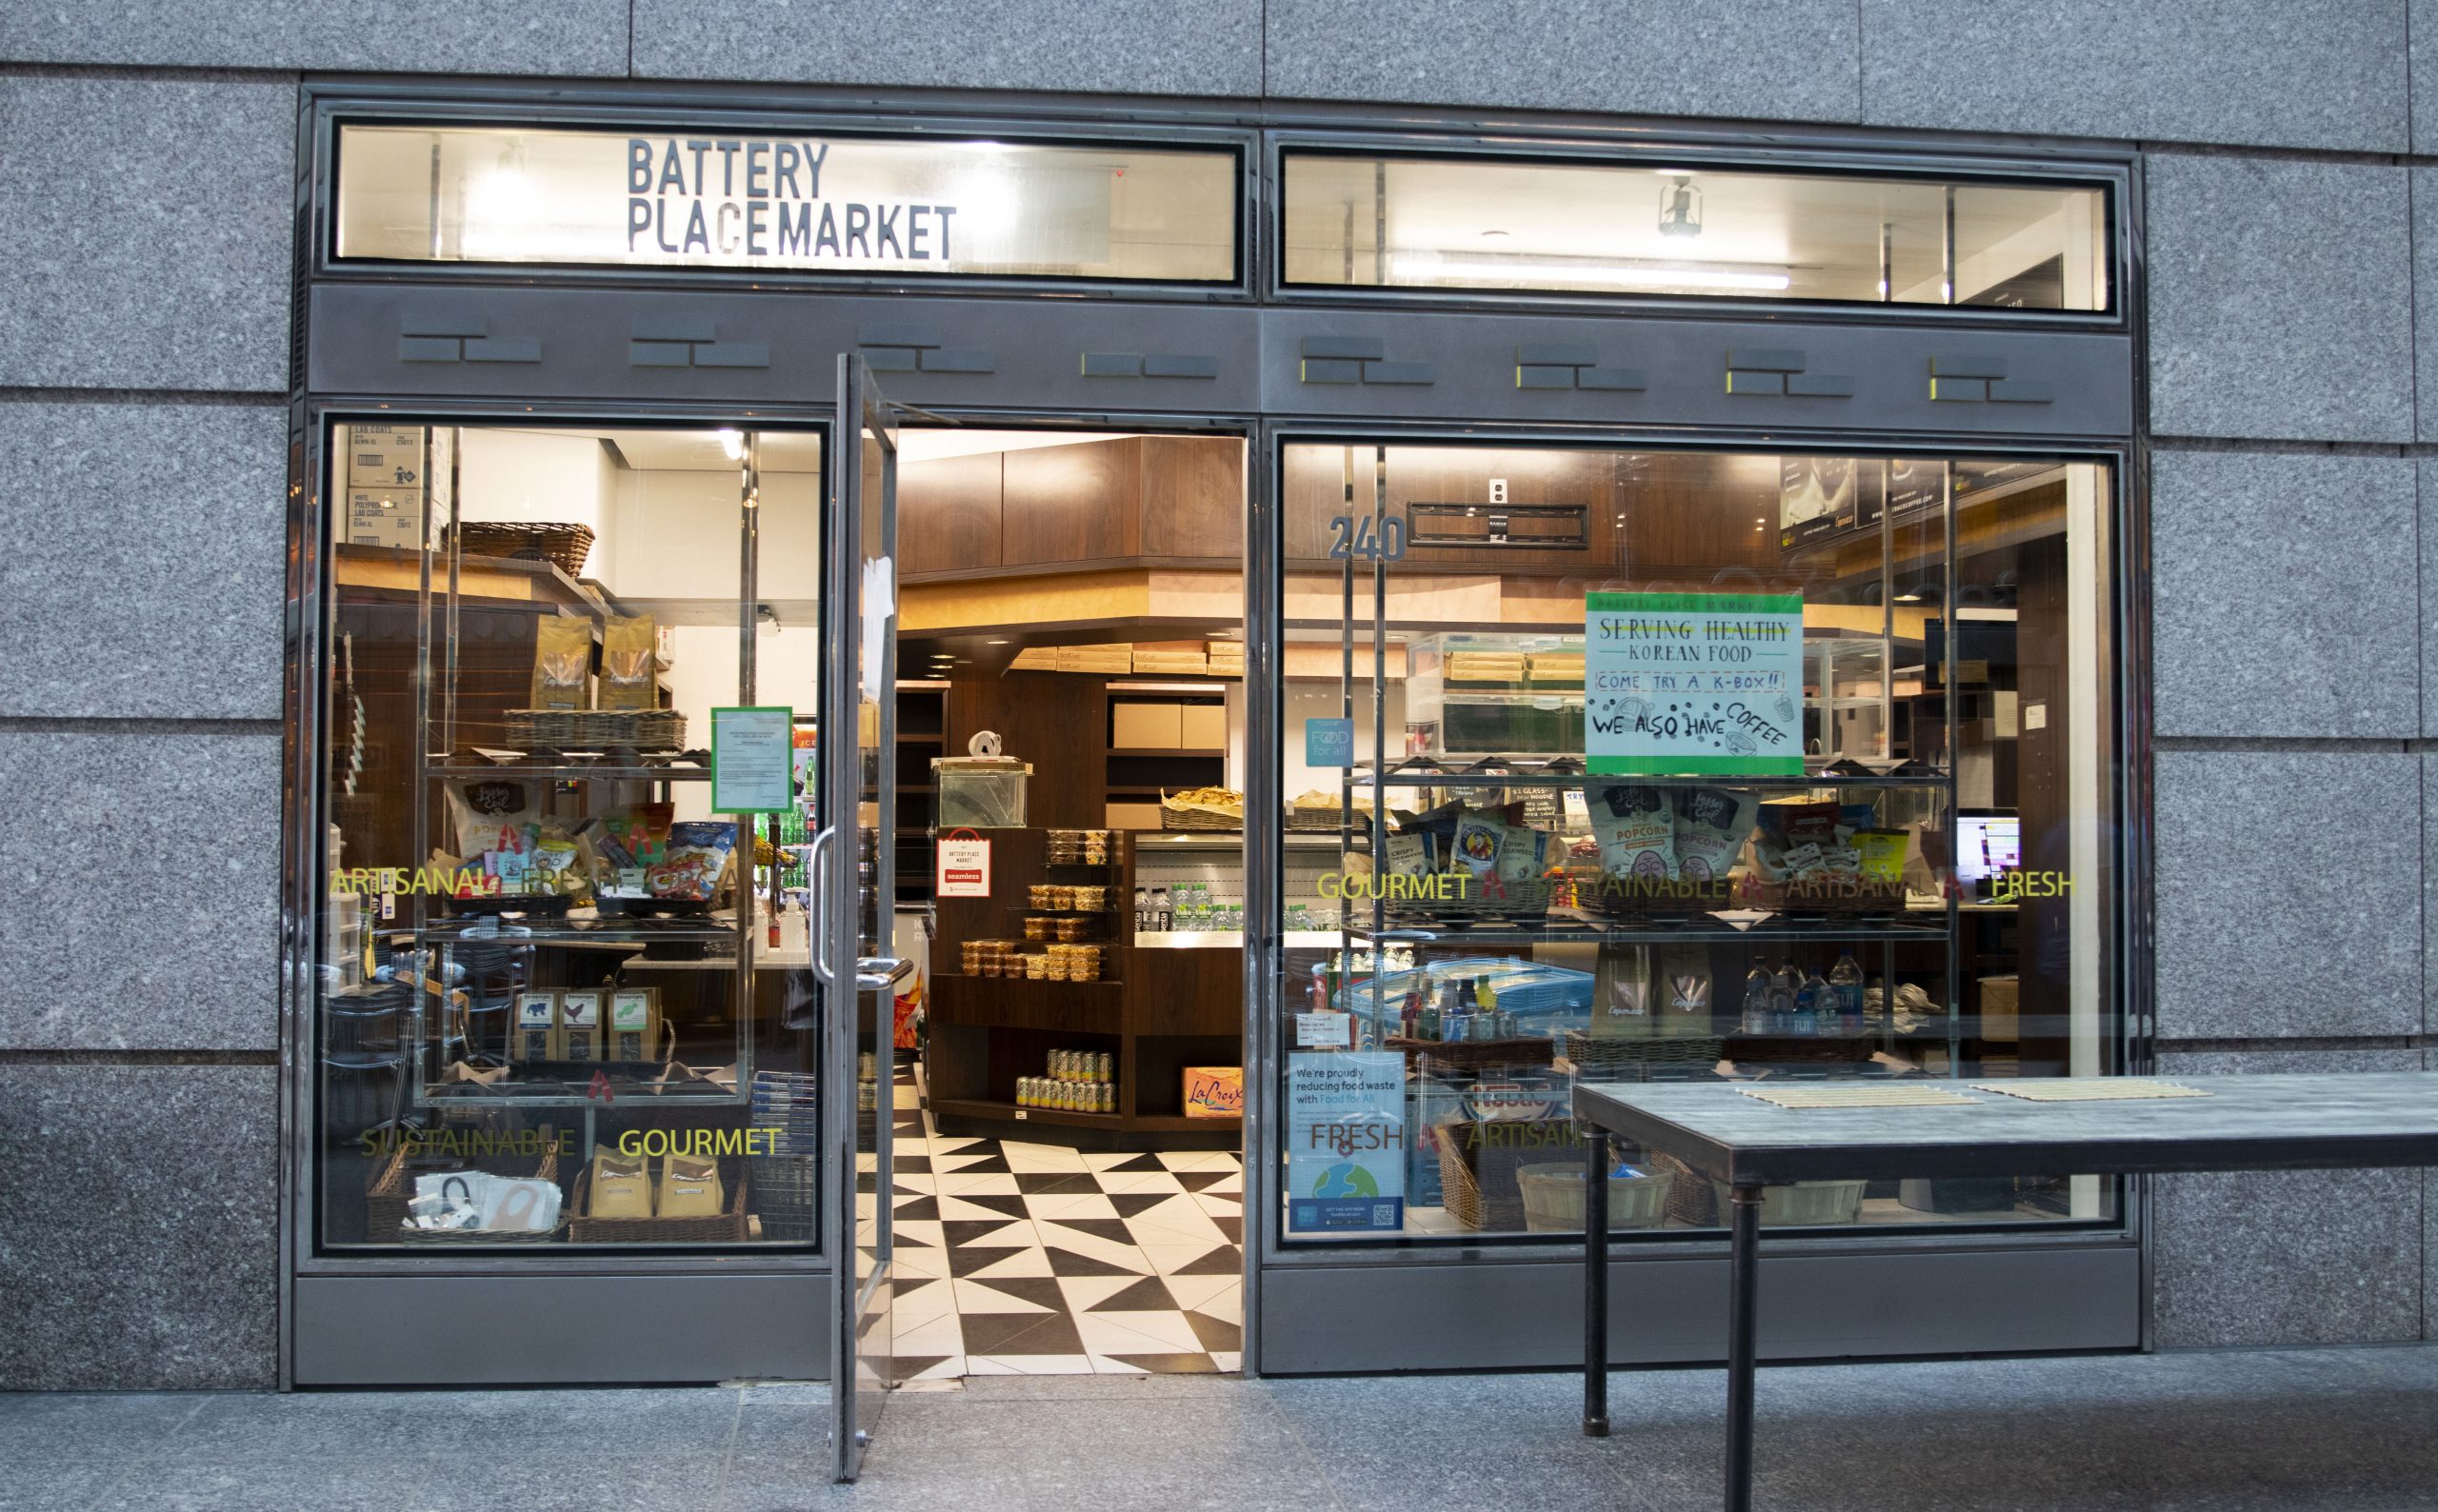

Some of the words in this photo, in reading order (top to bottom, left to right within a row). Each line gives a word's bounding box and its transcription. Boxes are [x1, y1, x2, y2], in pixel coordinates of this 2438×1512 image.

[628, 139, 829, 199] BATTERY
[1329, 515, 1406, 562] 240
[1599, 617, 1692, 641] SERVING
[1706, 619, 1789, 642] HEALTHY
[1629, 644, 1700, 662] KOREAN
[1709, 645, 1753, 663] FOOD
[1598, 674, 1641, 688] COME
[1655, 675, 1677, 688] TRY
[1687, 675, 1699, 688] A
[1592, 715, 1624, 735] WE
[1635, 715, 1678, 736] ALSO
[1688, 717, 1727, 736] HAVE
[1726, 701, 1788, 746] COFFEE
[1310, 730, 1349, 745] FOOD
[1311, 745, 1330, 756] for
[1333, 745, 1347, 756] all
[1616, 825, 1669, 841] POPCORN
[1674, 831, 1727, 850] POPCORN
[1391, 847, 1414, 857] CRISPY
[1392, 850, 1424, 862] SEAWEED
[1502, 847, 1534, 856] SEAWEED
[330, 867, 496, 895] ARTISANAL
[521, 867, 619, 895] FRESH
[649, 866, 798, 895] ORGANC
[1317, 872, 1473, 900] GOURMET
[1786, 871, 1928, 898] ARTISANAL
[1991, 870, 2078, 897] FRESH
[1793, 1020, 1810, 1032] FIJI
[1296, 1068, 1325, 1079] We're
[1327, 1068, 1365, 1081] proudly
[1296, 1082, 1341, 1093] reducing
[1341, 1081, 1365, 1091] food
[1366, 1081, 1396, 1091] waste
[1296, 1094, 1318, 1104] with
[1320, 1094, 1344, 1104] Food
[1346, 1094, 1361, 1104] for
[1362, 1094, 1376, 1104] All
[360, 1128, 576, 1158] SUSTAINABLE
[618, 1127, 783, 1157] GOURMET
[1309, 1124, 1404, 1150] FRESH
[1465, 1123, 1585, 1150] ARTISAN
